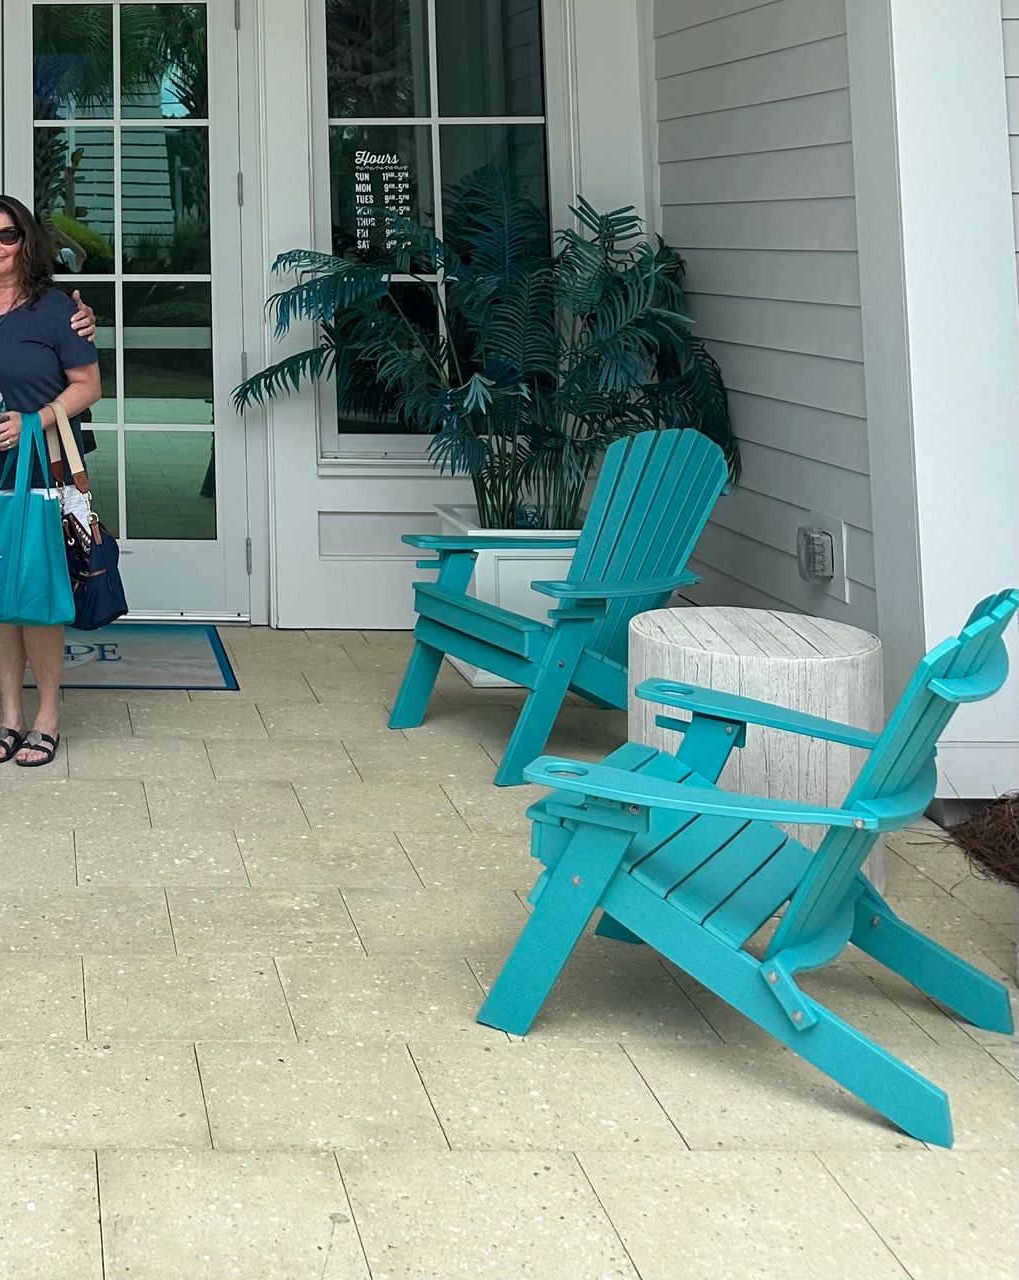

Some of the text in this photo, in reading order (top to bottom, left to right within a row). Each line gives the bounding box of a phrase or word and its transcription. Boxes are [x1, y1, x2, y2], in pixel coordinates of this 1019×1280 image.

[355, 150, 399, 166] Hours
[355, 172, 370, 181] SUN
[355, 183, 371, 192] MON
[356, 194, 374, 204] TUES
[357, 240, 370, 249] SAT
